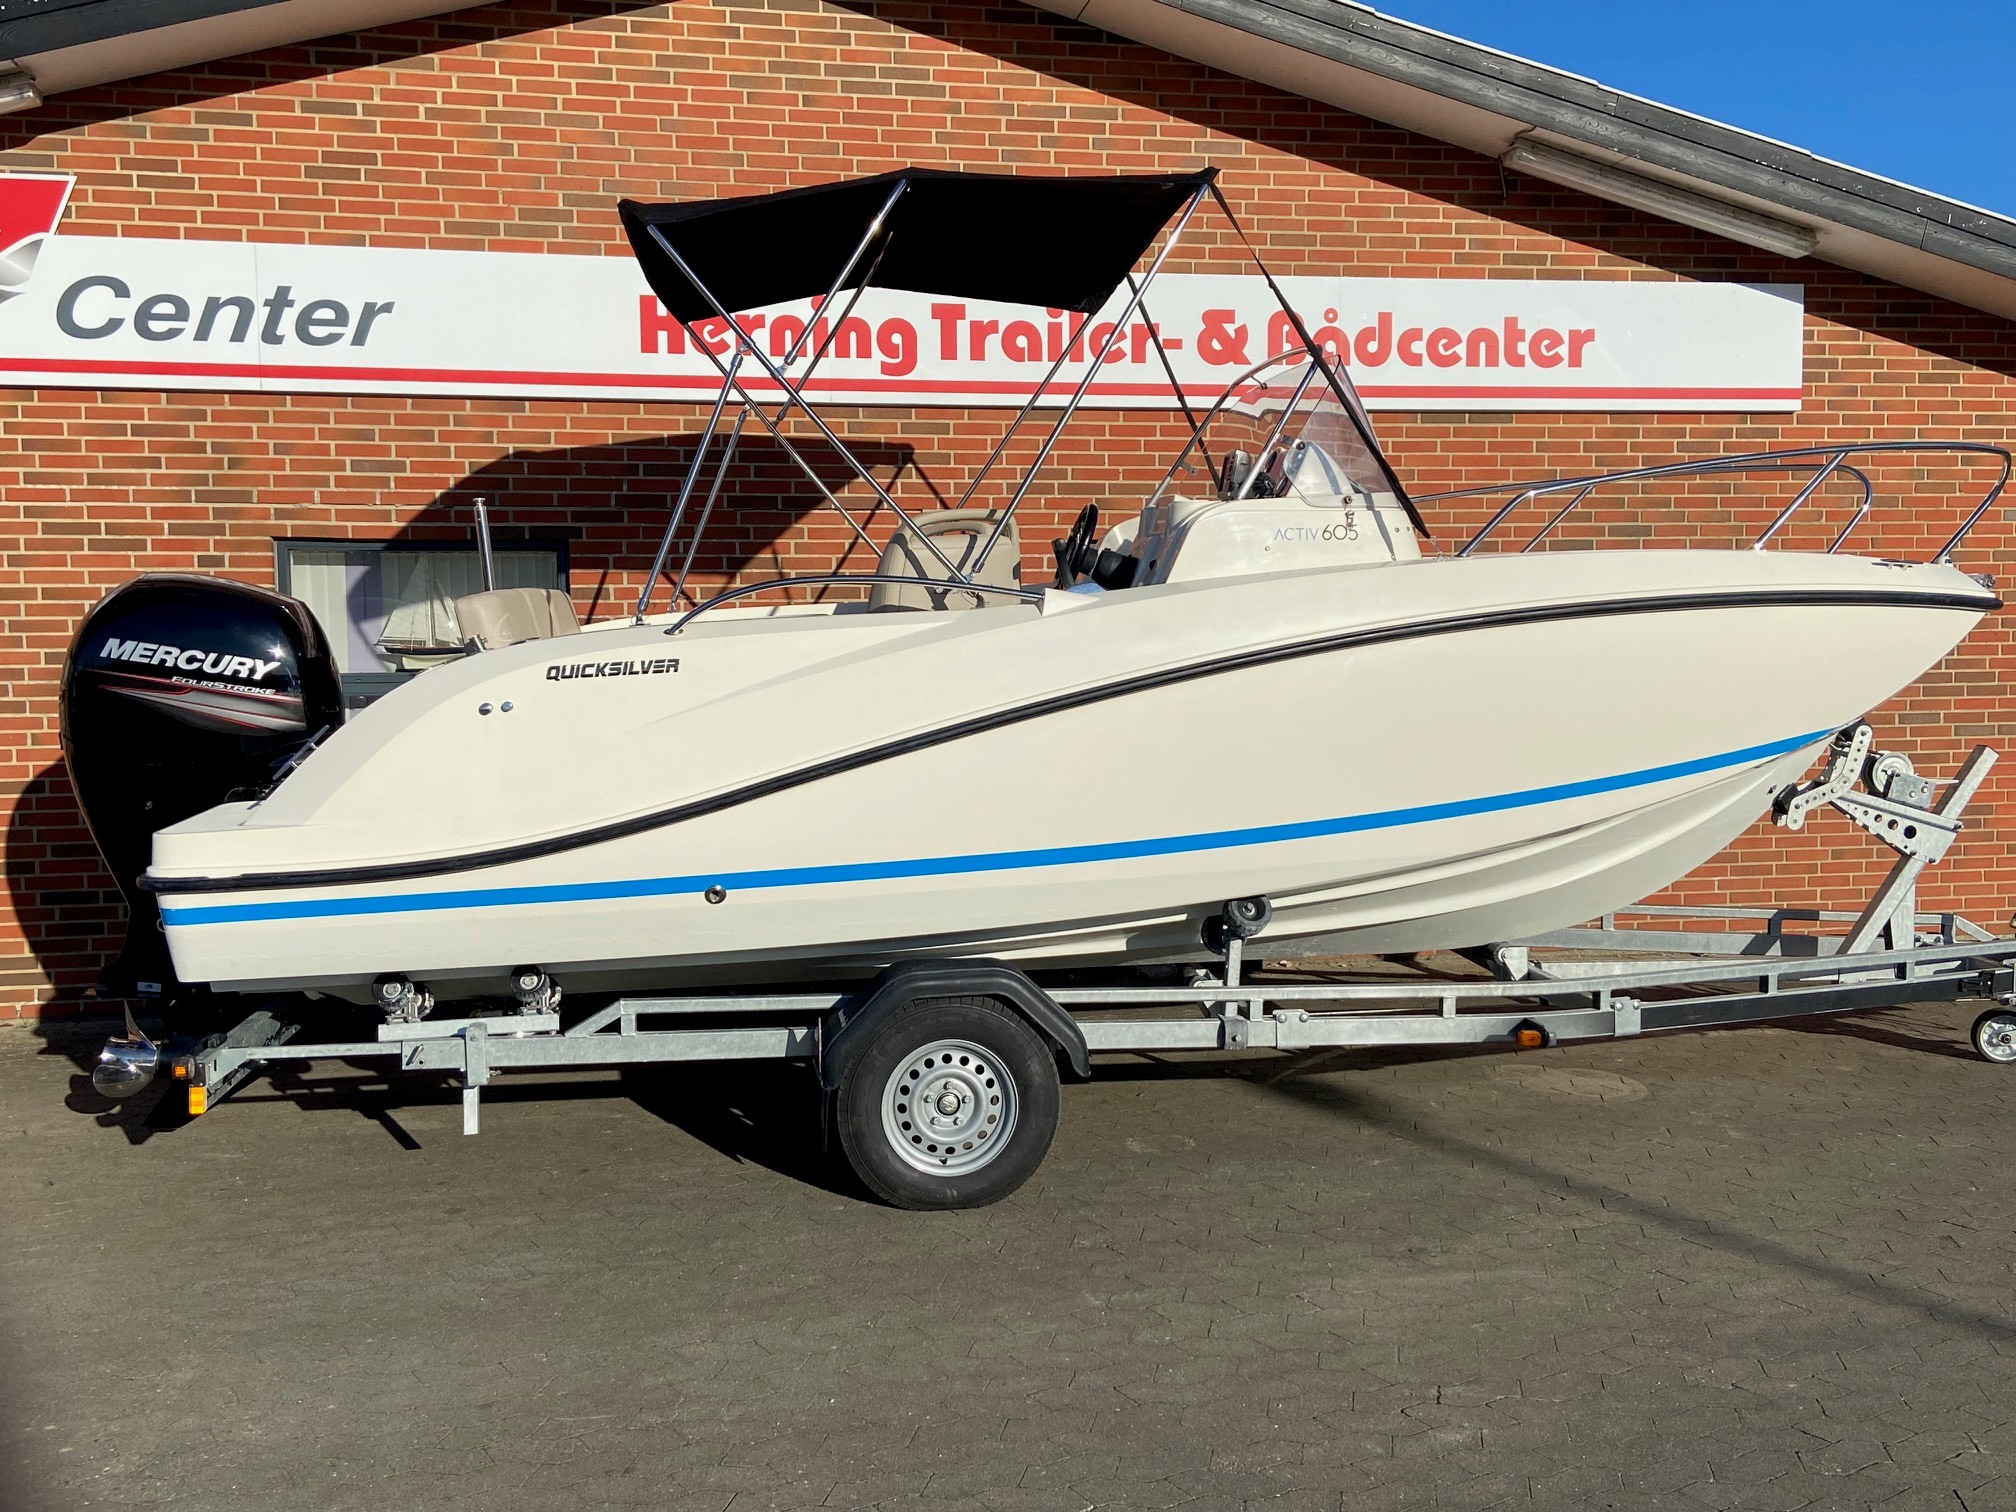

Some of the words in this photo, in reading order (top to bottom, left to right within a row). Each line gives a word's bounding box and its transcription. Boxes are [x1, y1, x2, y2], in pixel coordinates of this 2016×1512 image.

[56, 275, 395, 347] Center
[639, 294, 918, 376] Herning
[931, 302, 1183, 364] Trailer-
[1197, 308, 1252, 366] &
[1267, 307, 1596, 369] Bådcenter
[1274, 527, 1319, 541] ACTIV
[1321, 524, 1359, 541] 605
[99, 637, 282, 680] MERCURY
[545, 658, 680, 682] QUICKSILVER
[170, 675, 277, 695] FOURSTROKE
